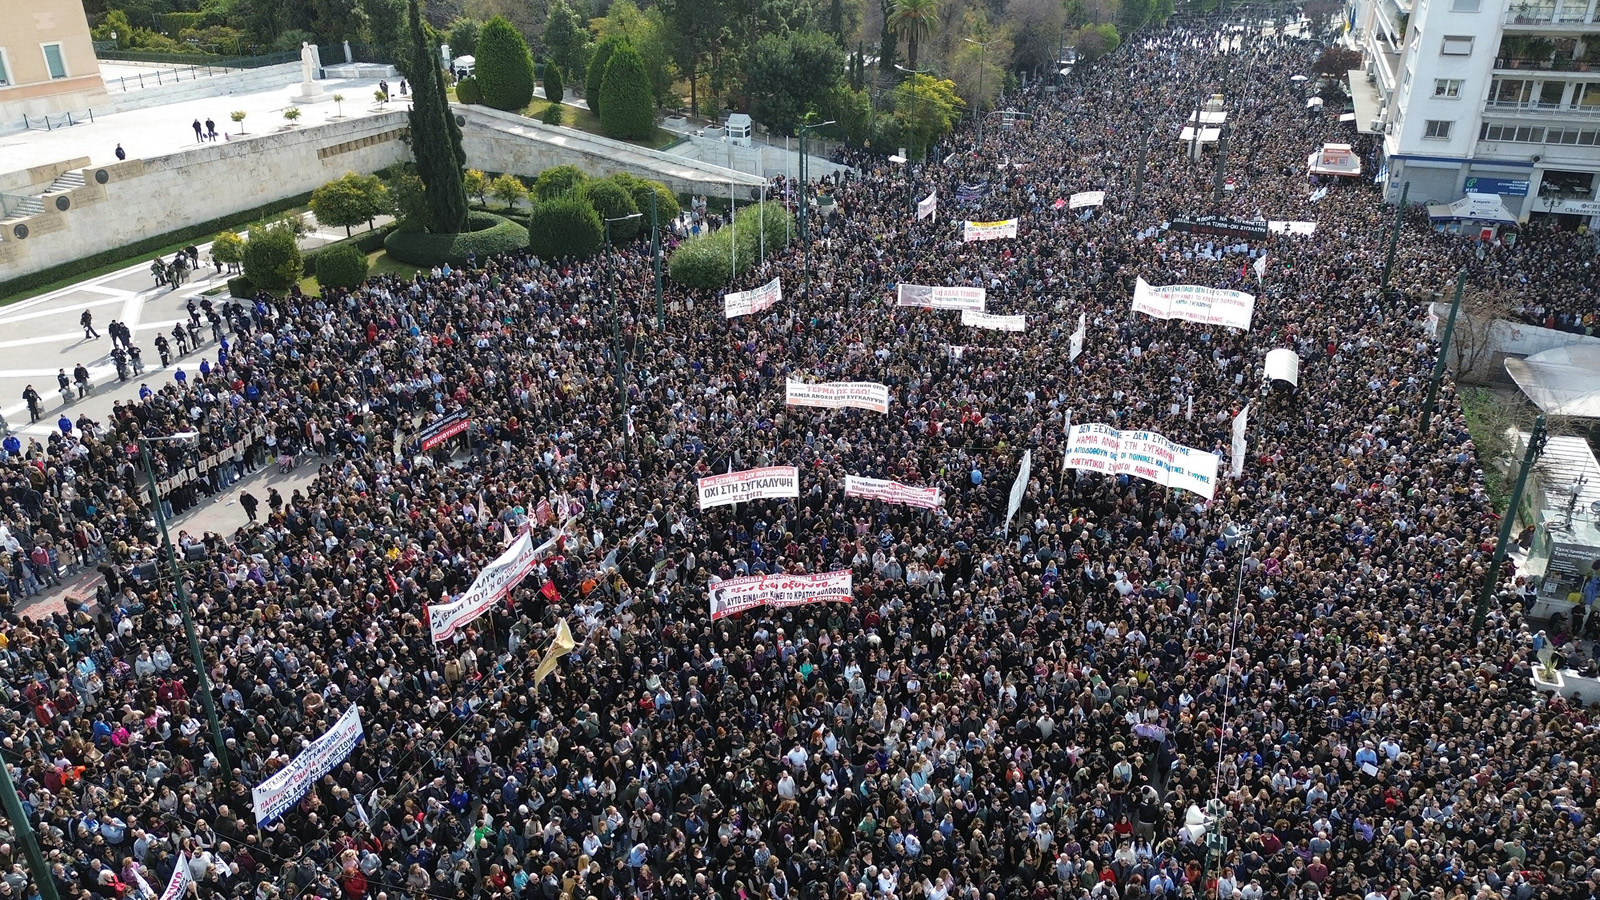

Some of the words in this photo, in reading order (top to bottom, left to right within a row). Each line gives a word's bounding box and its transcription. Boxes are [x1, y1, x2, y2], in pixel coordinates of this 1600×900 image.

[806, 386, 835, 395] ΤΕΡΜΑ
[836, 387, 848, 395] ΩΣ
[1078, 424, 1090, 434] ΔΕΝ
[1132, 432, 1149, 441] ΔΕΝ
[1075, 435, 1098, 444] ΚΑΜΙΑ
[1124, 441, 1138, 450] ΣΤΗ
[1073, 447, 1108, 457] ΑΠΟΔΟΘΟΥΝ
[1120, 452, 1127, 460] ΟΙ
[1128, 453, 1154, 465] ΠΟΙΝΙΚΕΣ
[1070, 457, 1105, 470] ΦΟΙΤΗΤΙΚΟΙ
[1134, 465, 1159, 480] ΑΘΗΝΑΣ
[704, 487, 719, 499] ΟΧΙ
[721, 483, 738, 495] ΣΤΗ
[741, 478, 793, 493] ΣΥΓΚΑΛΥΨΗ
[466, 588, 488, 605] ΤΟΥΣ
[497, 576, 504, 585] ΟΙ
[519, 548, 532, 565] ΜΑΣ
[714, 576, 763, 589] ΟΜΟΣΠΟΝΔΙΑ
[816, 570, 849, 581] ΕΛΛΑΔΑΣ
[727, 595, 742, 607] ΑΥΤΟ
[787, 592, 793, 600] ΤΟ
[794, 591, 816, 600] ΚΡΑΤΟΣ
[816, 587, 849, 597] ΔΟΛΟΦΟΝΟ
[720, 600, 761, 616] ΣΥΝΔΙΚΑΤΟ
[269, 789, 306, 820] ΕΡΓΑΤΙΚΟ
[332, 742, 357, 768] ΠΕΙΡΑΙΑ
[278, 790, 292, 807] ΜΑΣ
[310, 766, 320, 777] ΝΑ
